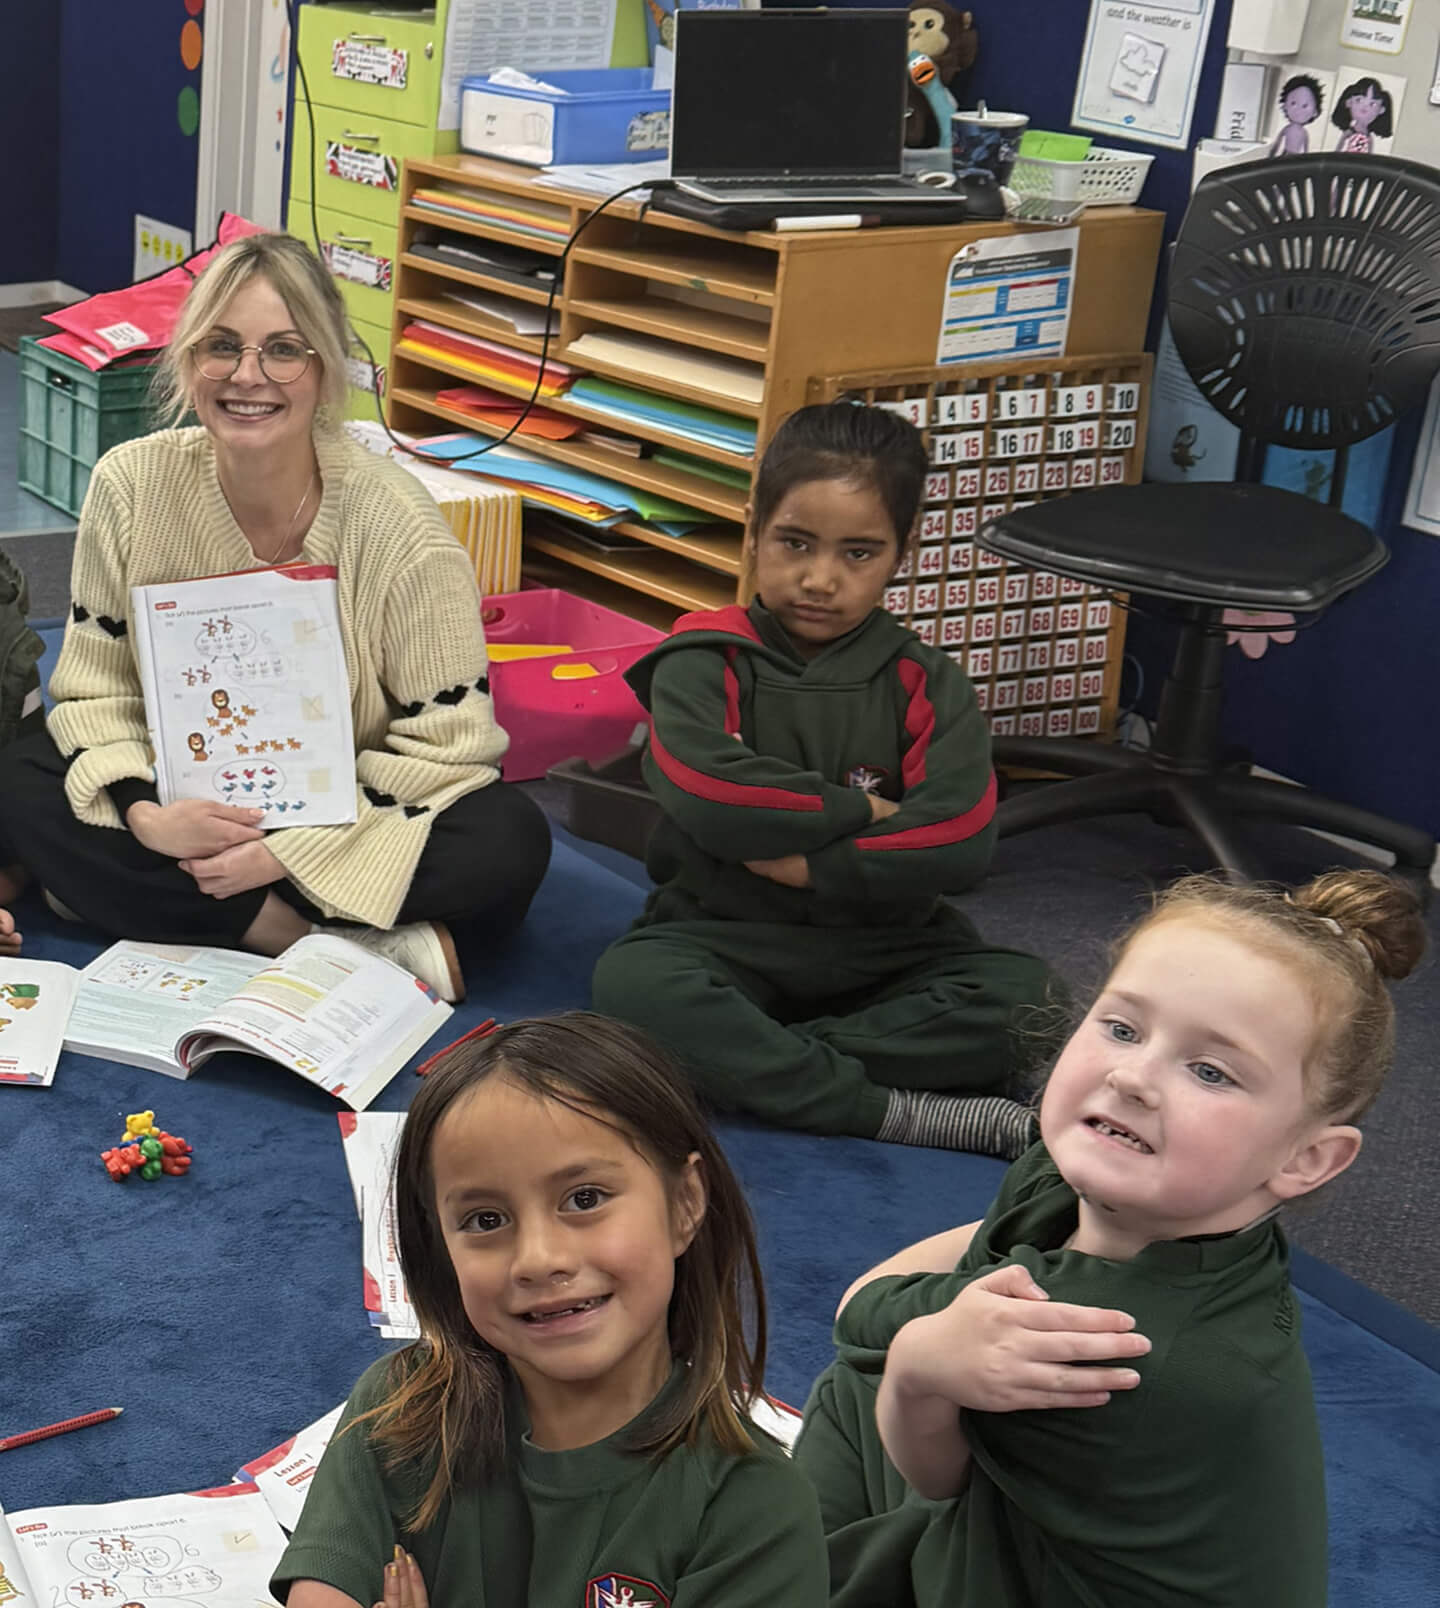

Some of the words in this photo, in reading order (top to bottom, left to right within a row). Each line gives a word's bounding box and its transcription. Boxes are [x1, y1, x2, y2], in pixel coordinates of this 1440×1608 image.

[910, 405, 919, 424] 3
[947, 401, 956, 420] 4
[971, 400, 979, 419] 5
[1009, 396, 1017, 415] 6
[1030, 395, 1038, 413] 7
[1066, 393, 1073, 412] 8
[1087, 391, 1094, 409] 9
[1119, 390, 1133, 409] 10
[940, 441, 956, 460] 14
[965, 438, 979, 456] 15
[1001, 434, 1017, 454] 16
[1023, 432, 1038, 451] 17
[1059, 431, 1073, 449] 18
[1080, 428, 1094, 446] 19
[1114, 426, 1132, 445] 20
[928, 477, 947, 498] 24
[959, 475, 978, 495] 25
[989, 472, 1007, 492] 26
[1018, 469, 1036, 488] 27
[1046, 467, 1065, 486] 28
[1074, 464, 1092, 484] 29
[1102, 461, 1121, 481] 30
[925, 515, 943, 535] 34
[955, 512, 974, 531] 35
[921, 551, 940, 571] 44
[952, 549, 971, 568] 45
[888, 591, 906, 611] 53
[917, 589, 936, 608] 54
[948, 586, 967, 606] 55
[978, 582, 996, 602] 56
[1007, 579, 1025, 599] 57
[1036, 576, 1053, 595] 58
[944, 621, 963, 641] 65
[975, 618, 993, 637] 66
[1004, 615, 1022, 635] 67
[1032, 612, 1051, 631] 68
[1060, 609, 1079, 628] 69
[1090, 606, 1107, 624] 70
[971, 652, 989, 672] 76
[1001, 649, 1019, 669] 77
[1030, 646, 1047, 666] 78
[1058, 643, 1075, 662] 79
[1086, 640, 1104, 659] 80
[997, 685, 1016, 705] 87
[1026, 682, 1044, 701] 88
[1054, 679, 1072, 698] 89
[1082, 675, 1100, 695] 90
[1022, 716, 1040, 734] 98
[1051, 713, 1069, 732] 99
[1079, 711, 1096, 729] 100
[274, 1458, 307, 1477] Lesson
